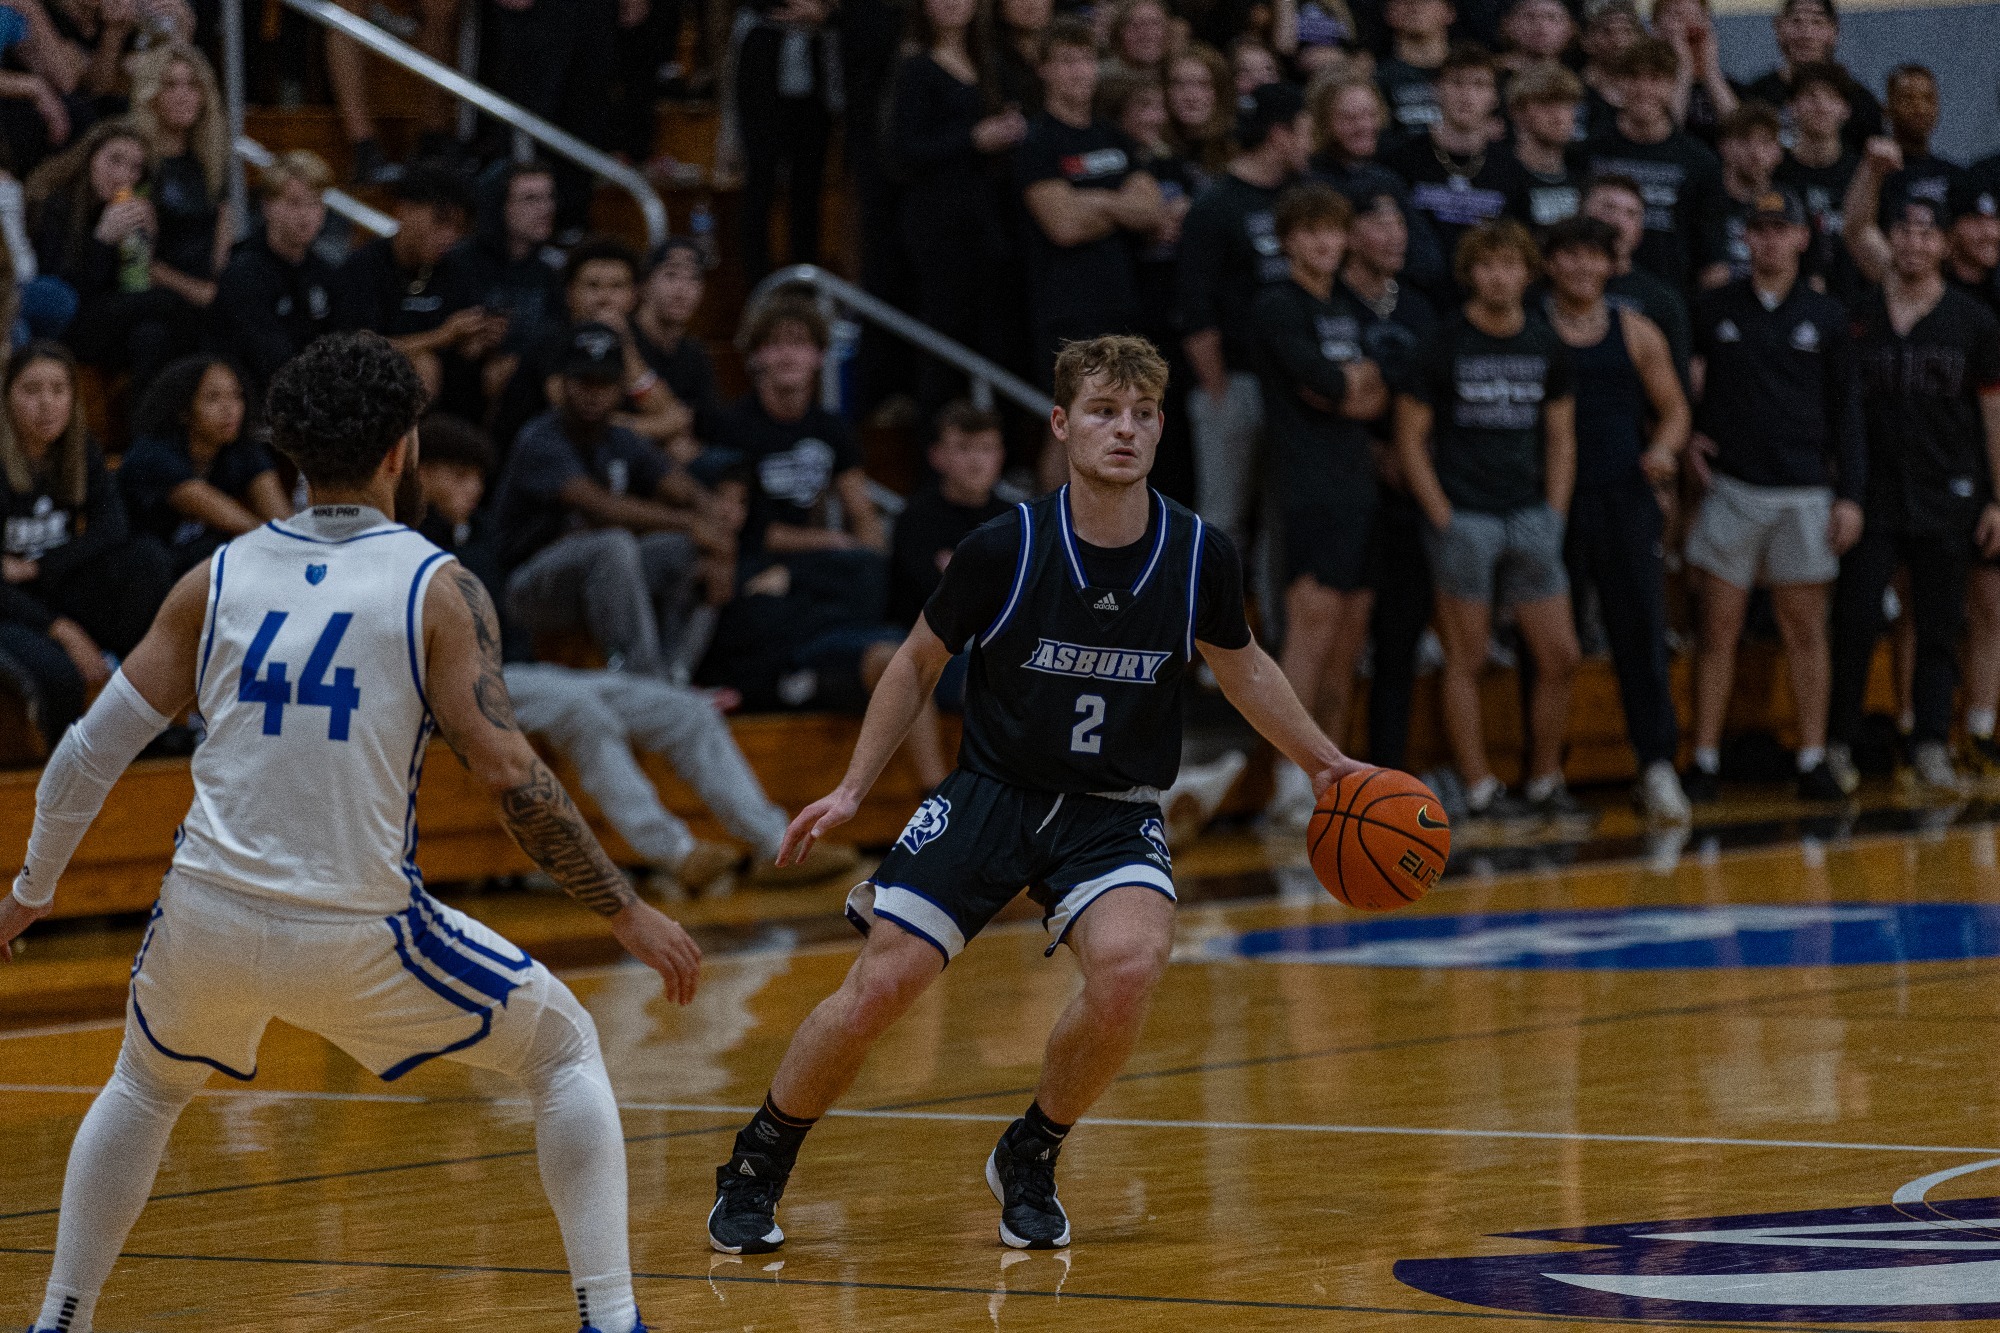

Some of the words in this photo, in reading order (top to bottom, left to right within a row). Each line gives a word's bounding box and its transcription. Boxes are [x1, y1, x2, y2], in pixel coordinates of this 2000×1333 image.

[335, 506, 360, 517] PRO
[1093, 602, 1120, 611] adidas
[238, 610, 360, 741] 44
[1033, 643, 1162, 680] ASBURY
[1070, 693, 1106, 755] 2
